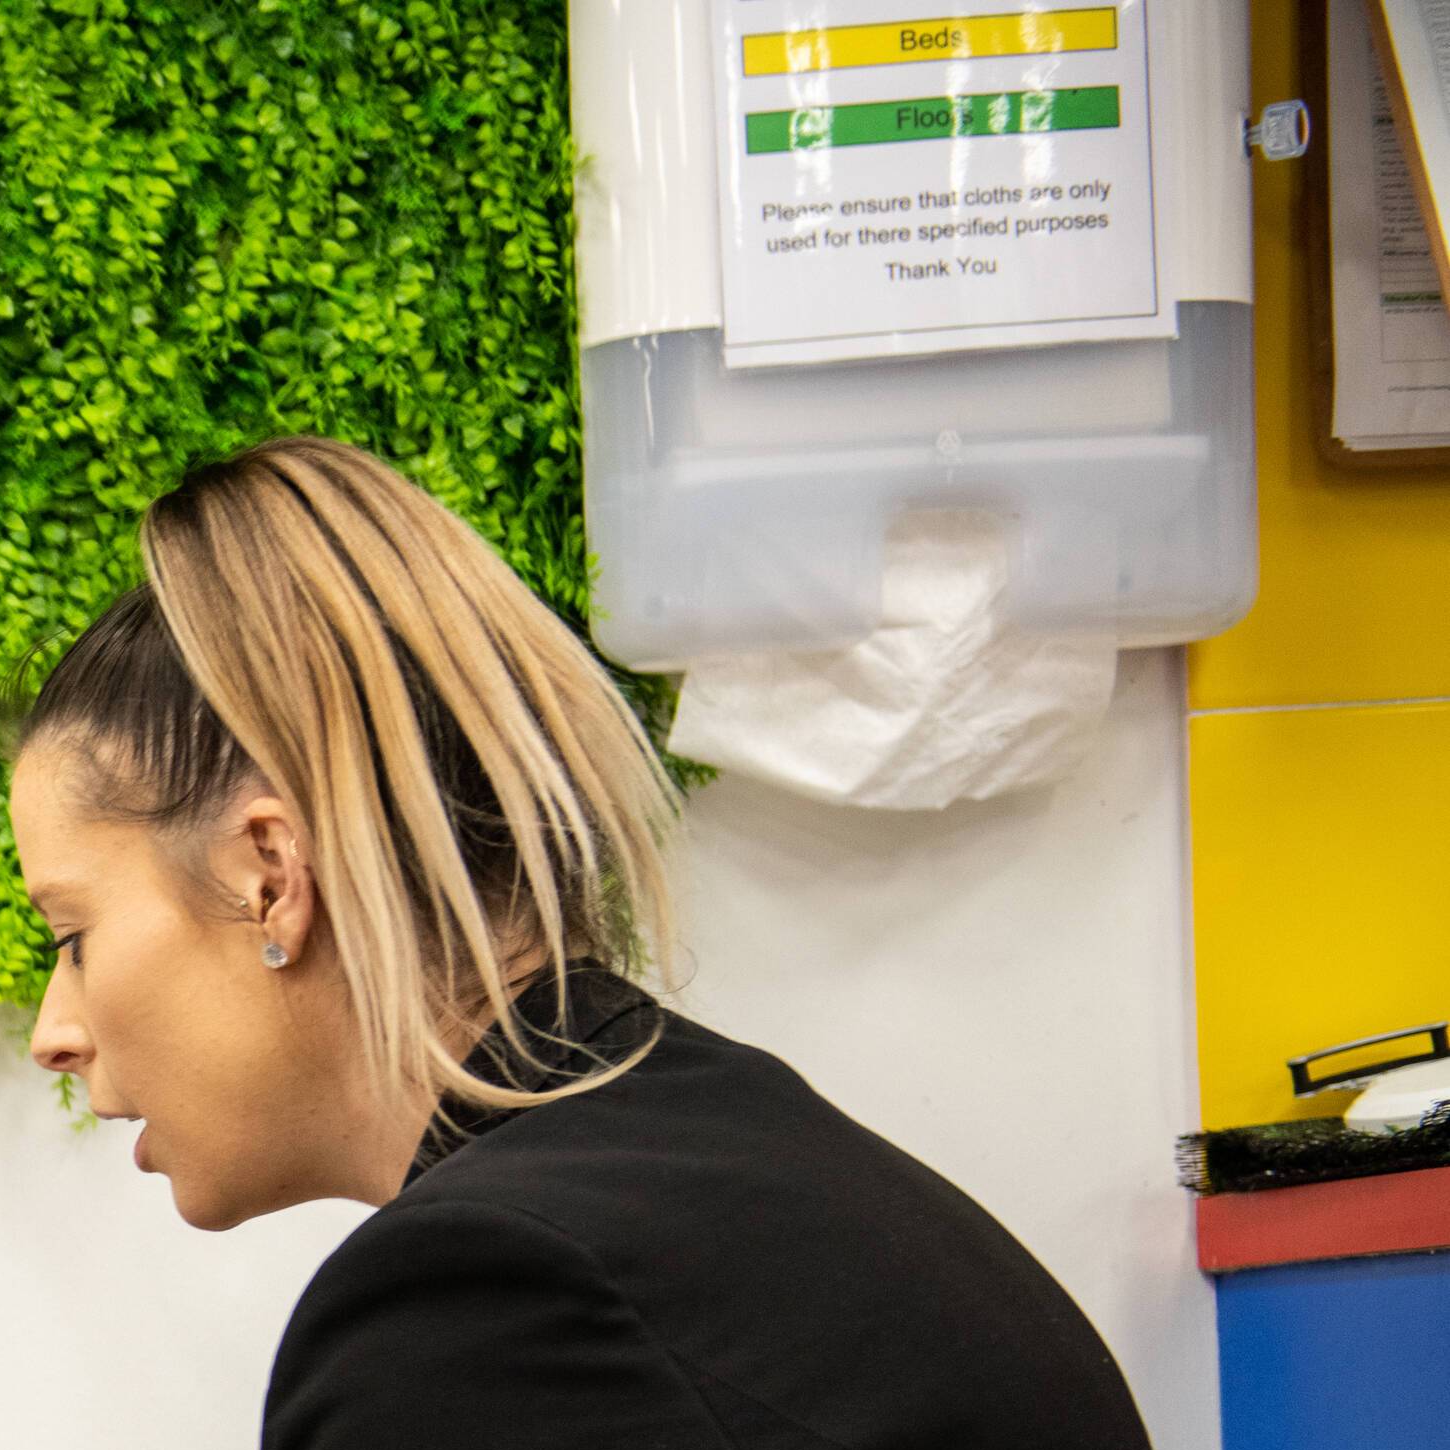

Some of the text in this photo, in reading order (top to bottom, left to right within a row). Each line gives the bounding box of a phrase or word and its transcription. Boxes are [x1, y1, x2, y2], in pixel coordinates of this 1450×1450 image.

[900, 25, 963, 52] Beds
[840, 195, 912, 217] ensure
[918, 190, 957, 209] that
[963, 186, 1022, 206] cloths
[1030, 185, 1063, 201] are
[1069, 179, 1111, 202] only
[767, 212, 1109, 254] used for there specified purposes
[884, 256, 998, 281] Thank You
